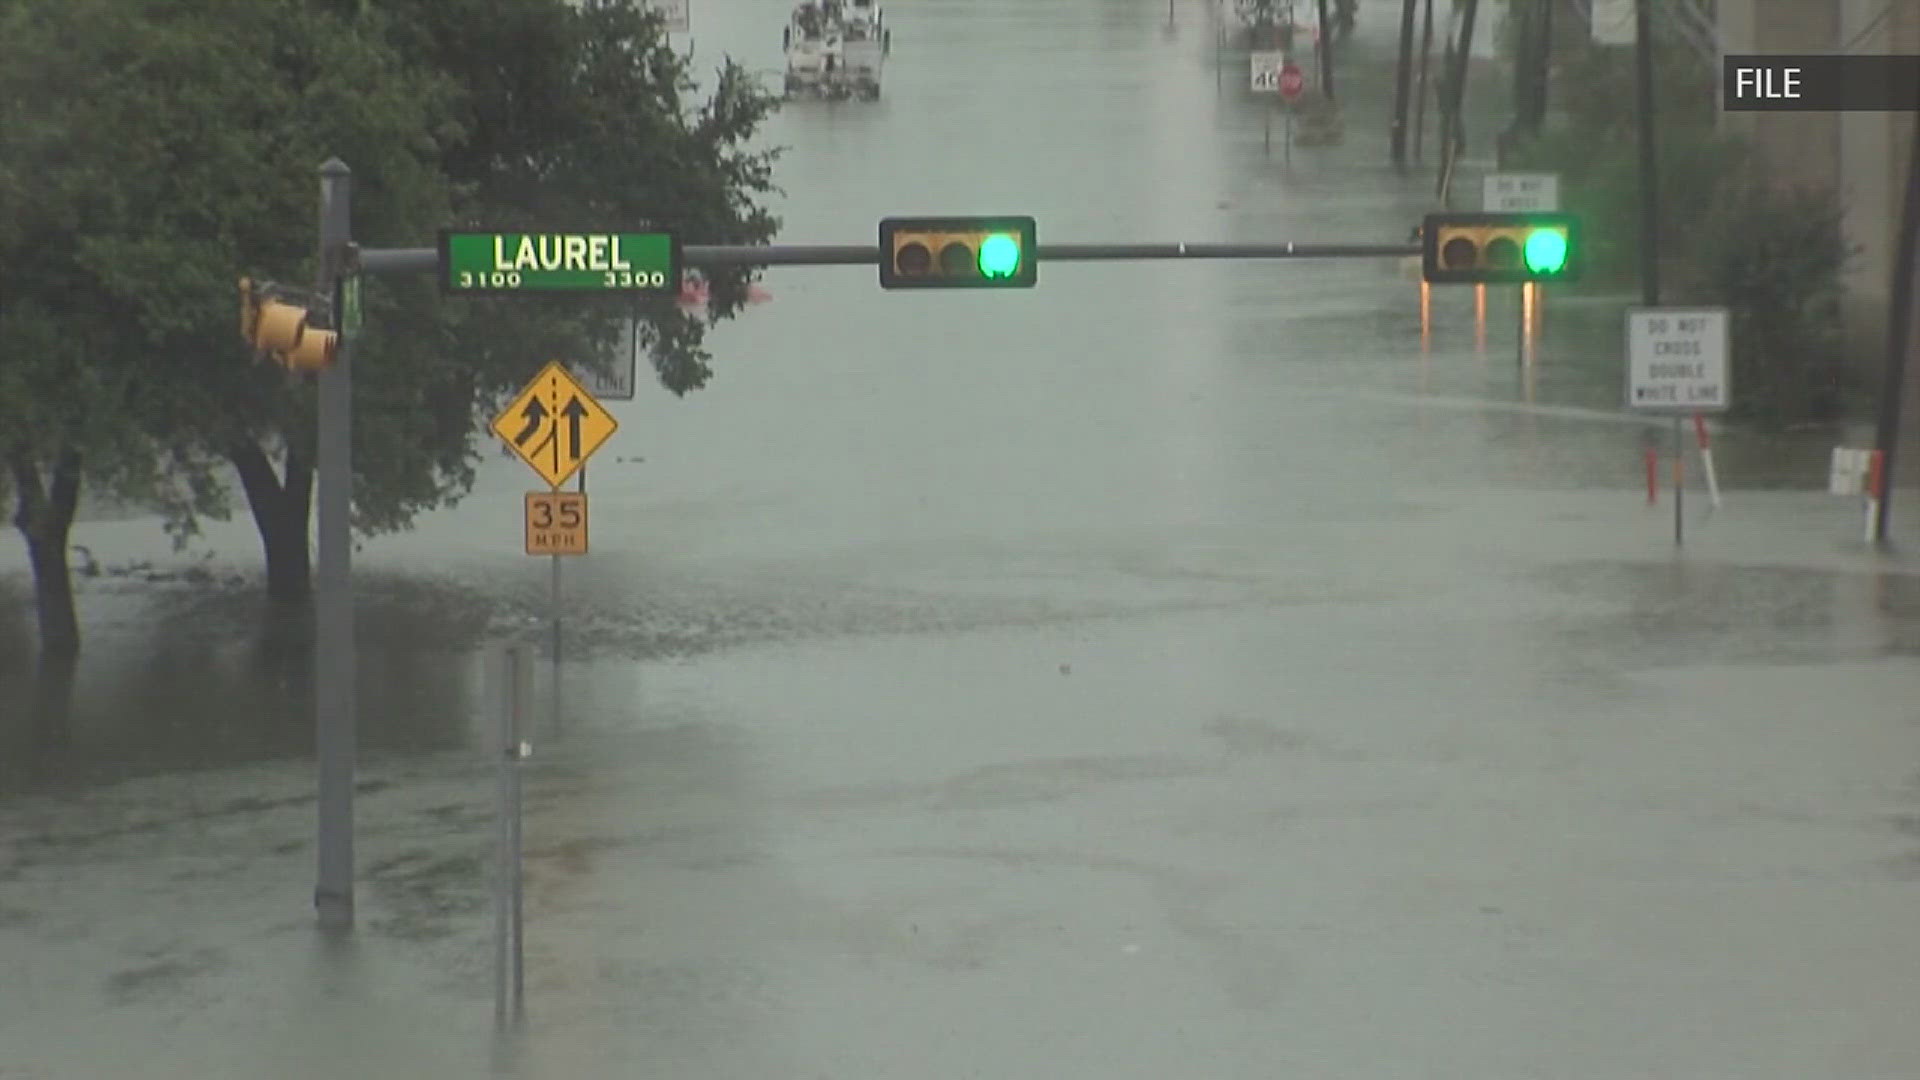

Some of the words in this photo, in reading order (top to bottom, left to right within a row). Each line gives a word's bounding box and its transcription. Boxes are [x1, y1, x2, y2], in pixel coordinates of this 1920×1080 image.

[494, 234, 631, 270] LAUREL
[460, 271, 521, 288] 3100
[604, 271, 665, 288] 3300
[1647, 318, 1668, 334] DO
[1648, 362, 1704, 379] DOUBLE
[533, 501, 580, 529] 35
